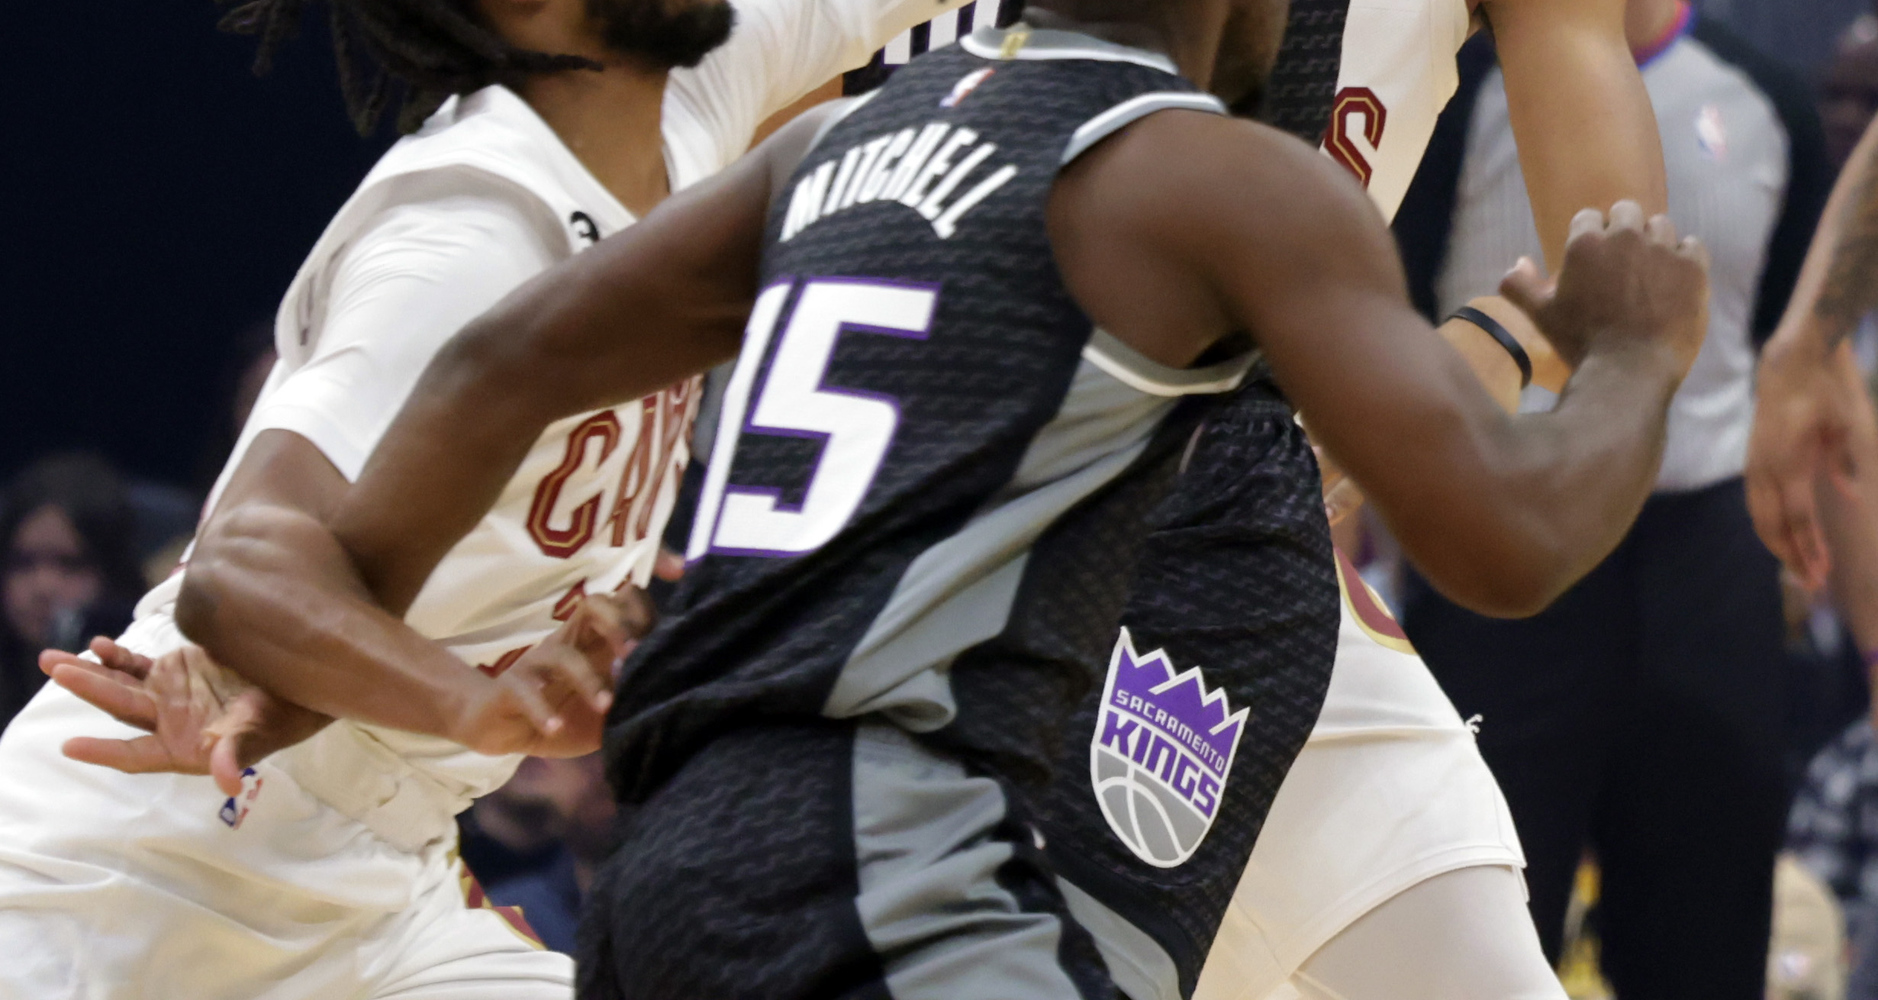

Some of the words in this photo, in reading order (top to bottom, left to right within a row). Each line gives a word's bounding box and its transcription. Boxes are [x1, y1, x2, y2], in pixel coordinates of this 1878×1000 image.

[779, 121, 1018, 240] MITCHELL
[683, 275, 942, 566] 15
[1100, 709, 1220, 821] KINGS
[1115, 688, 1226, 773] SACRAMENTO
